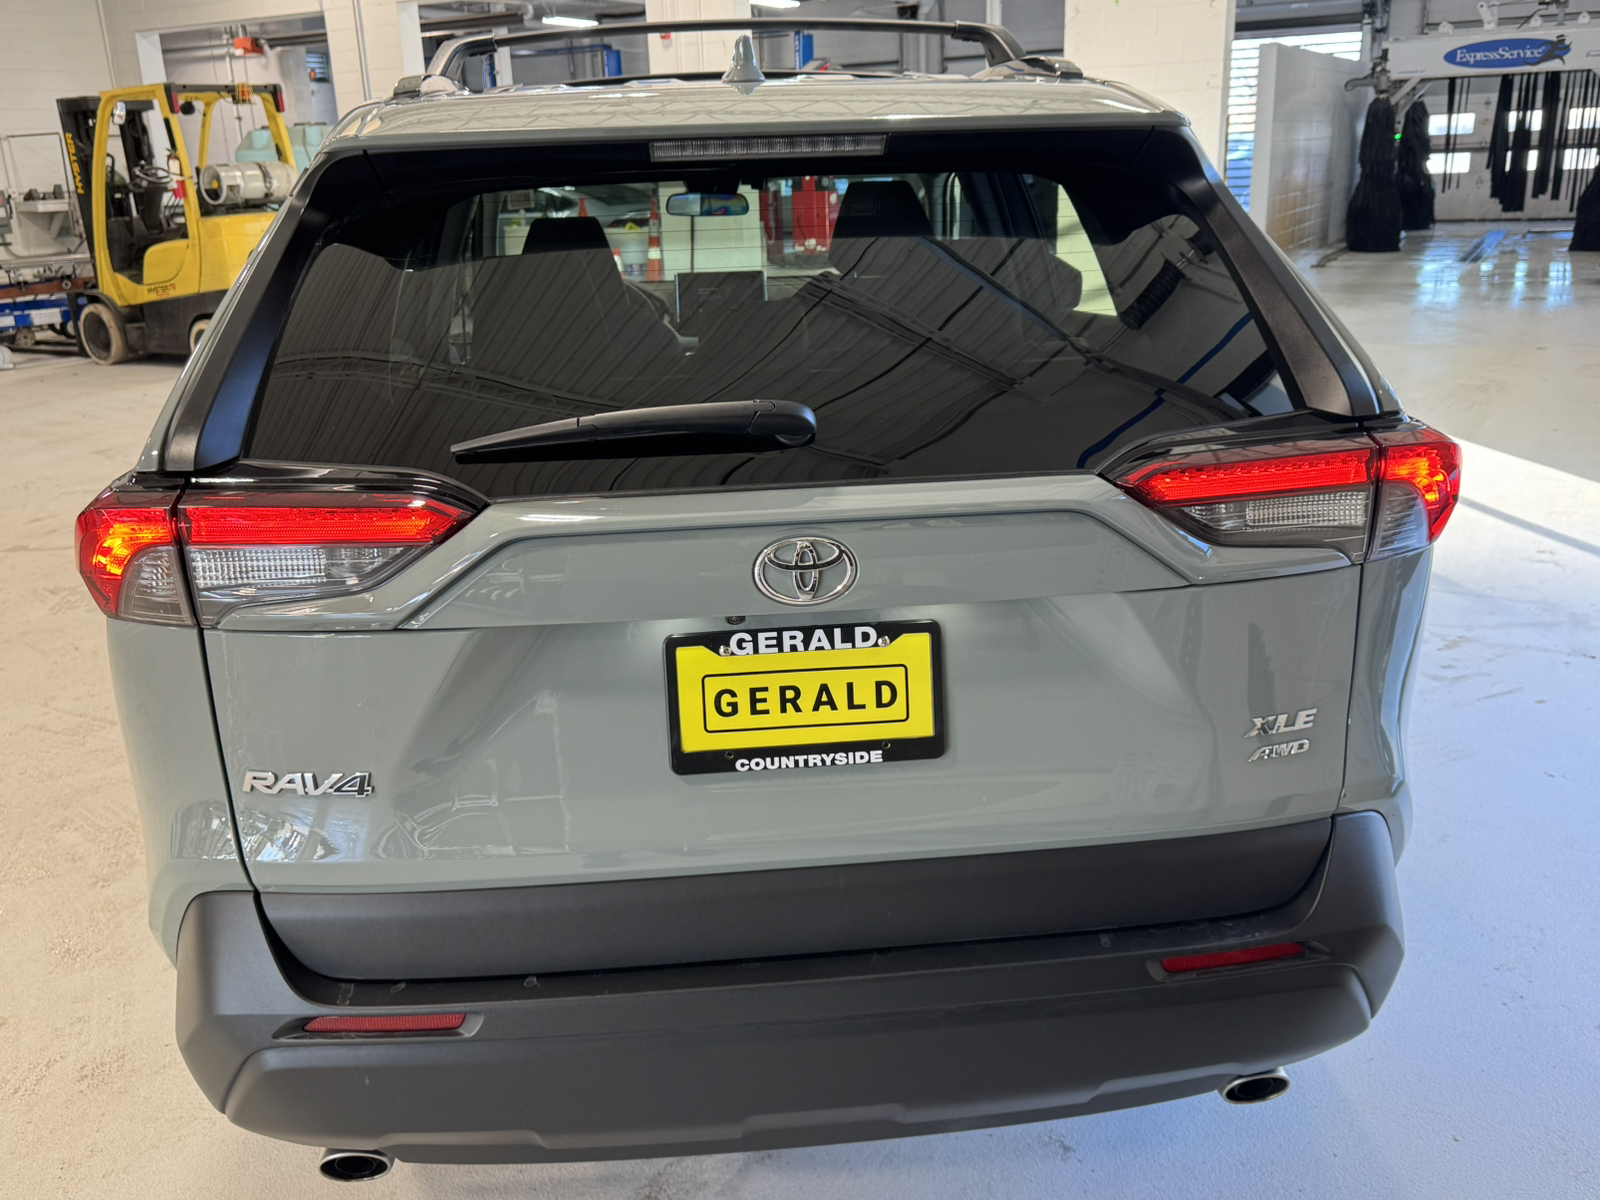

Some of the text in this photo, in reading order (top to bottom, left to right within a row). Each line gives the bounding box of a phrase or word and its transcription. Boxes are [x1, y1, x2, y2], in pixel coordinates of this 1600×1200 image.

[1456, 45, 1543, 64] ExpressService
[729, 626, 877, 655] GERALD
[713, 680, 898, 718] GERALD
[1244, 708, 1318, 738] XLE
[735, 750, 884, 771] COUNTRYSIDE
[1248, 739, 1310, 762] AWD
[242, 770, 374, 798] RAV4
